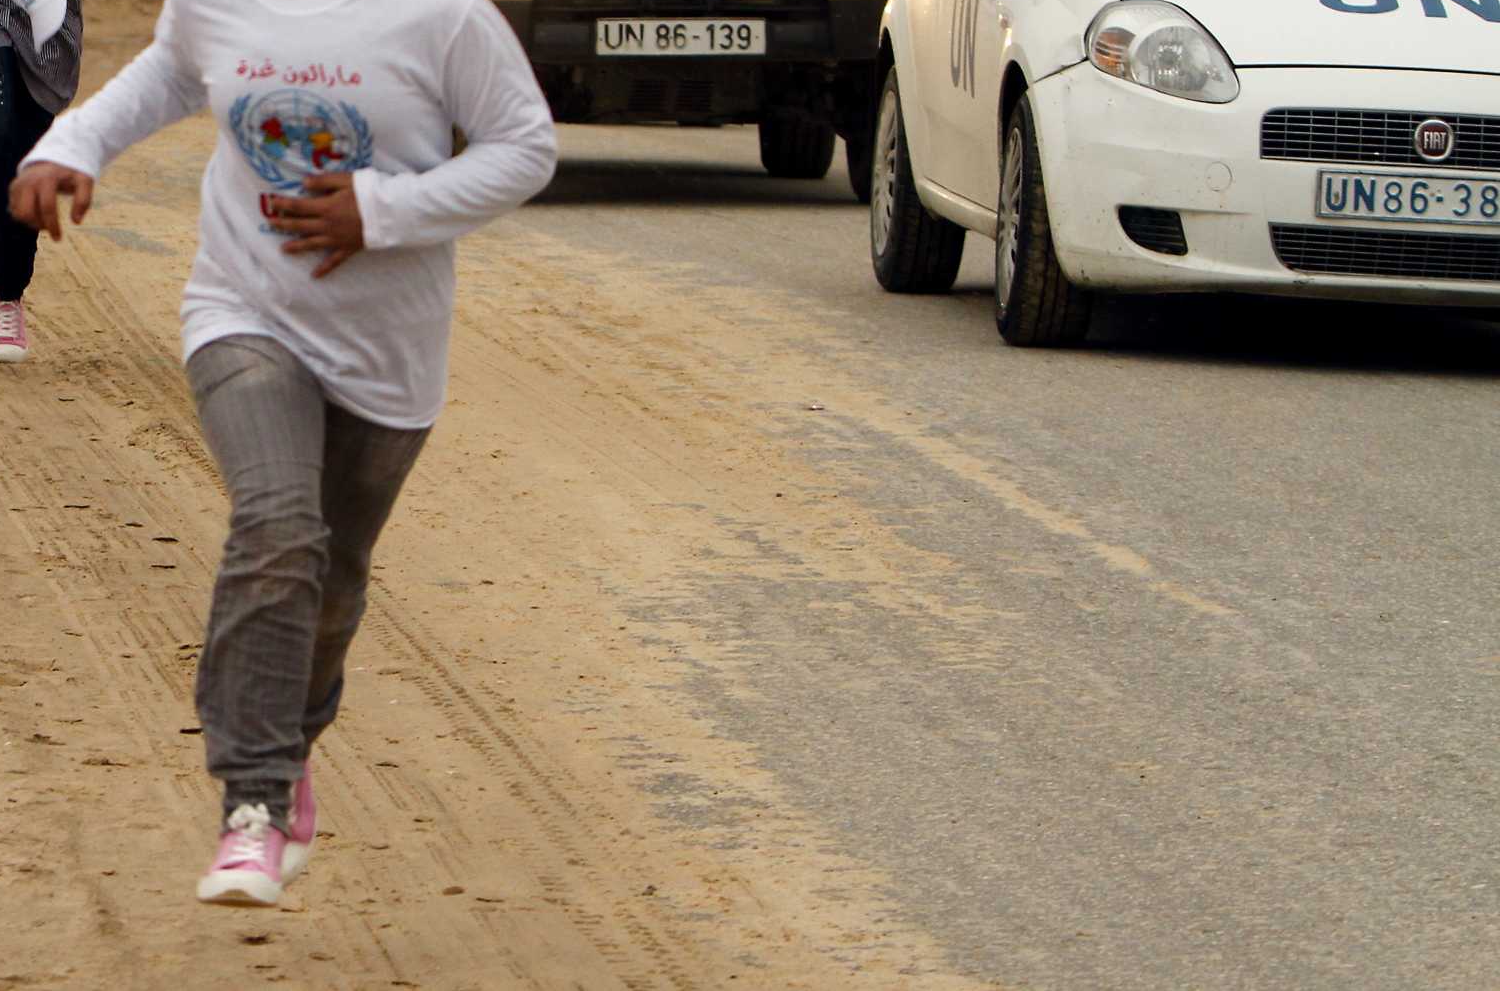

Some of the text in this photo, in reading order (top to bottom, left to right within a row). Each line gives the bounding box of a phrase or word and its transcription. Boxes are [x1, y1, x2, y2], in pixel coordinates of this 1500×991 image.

[604, 23, 645, 49] UN
[236, 57, 276, 80] غزة
[1423, 130, 1447, 150] FIAT
